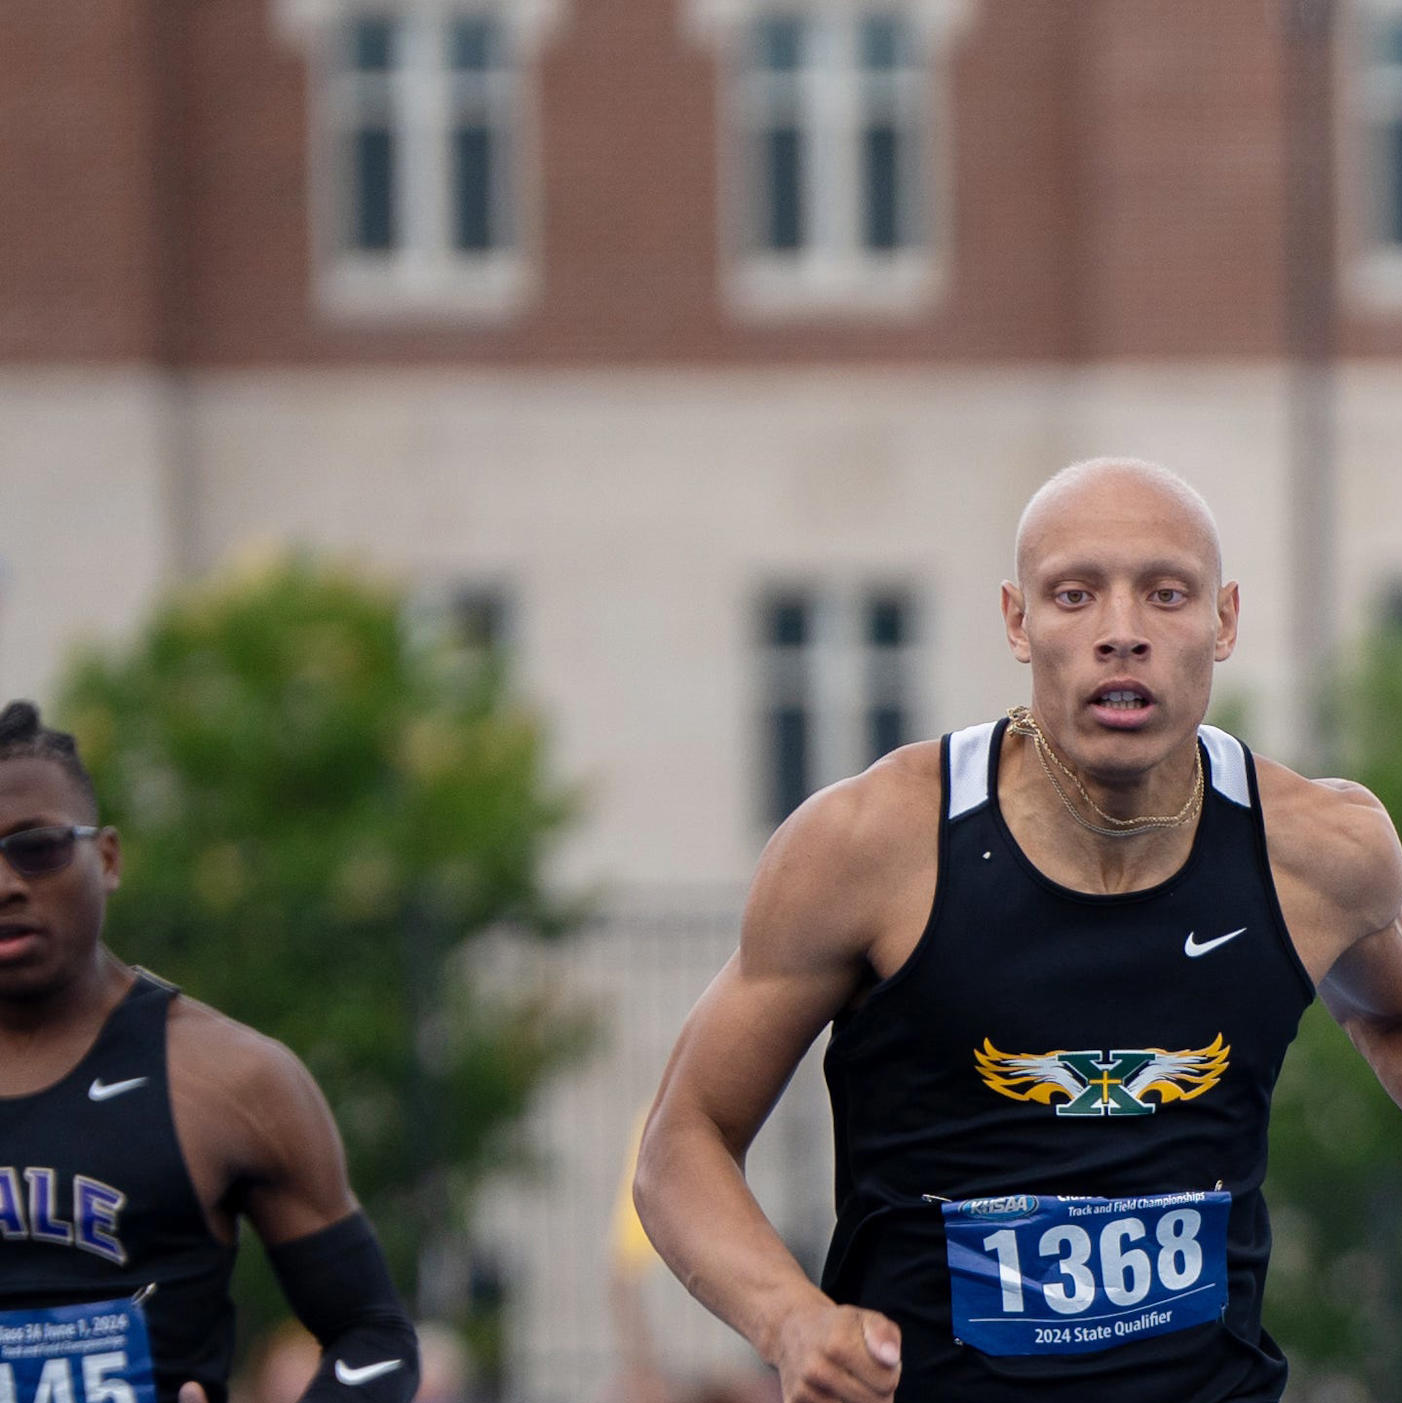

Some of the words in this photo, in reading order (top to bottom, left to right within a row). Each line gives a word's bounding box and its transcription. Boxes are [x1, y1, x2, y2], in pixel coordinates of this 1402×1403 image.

[1068, 1204, 1093, 1217] Track
[1093, 1202, 1113, 1214] and
[1114, 1197, 1137, 1213] Field
[1137, 1191, 1206, 1210] Championships
[983, 1208, 1203, 1314] 1368
[1034, 1328, 1072, 1344] 2024
[1074, 1325, 1112, 1342] State
[1114, 1310, 1173, 1336] Qualifier
